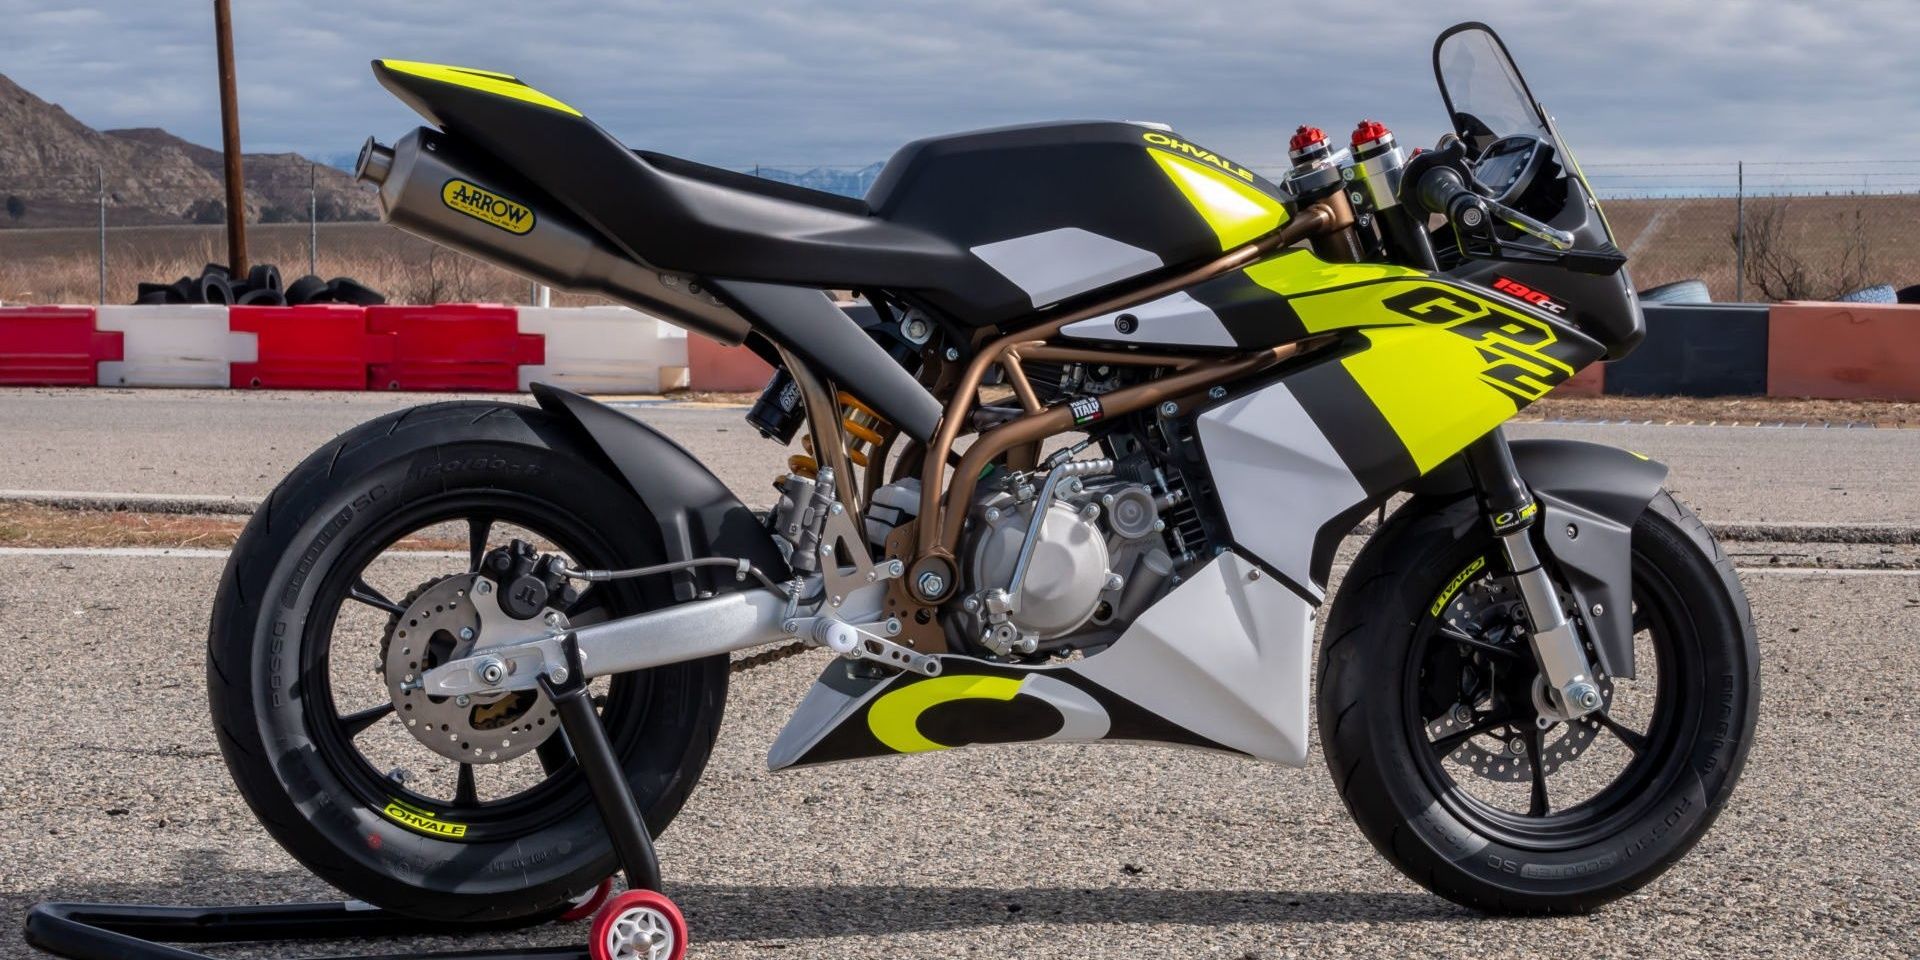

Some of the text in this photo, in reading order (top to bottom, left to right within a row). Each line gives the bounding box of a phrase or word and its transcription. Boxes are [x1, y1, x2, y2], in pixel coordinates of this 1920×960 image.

[1142, 132, 1255, 183] OHVALE
[452, 185, 529, 225] ARROW
[1073, 401, 1099, 418] ITALY
[1432, 559, 1483, 612] OHVALE
[388, 807, 466, 835] OHVALE
